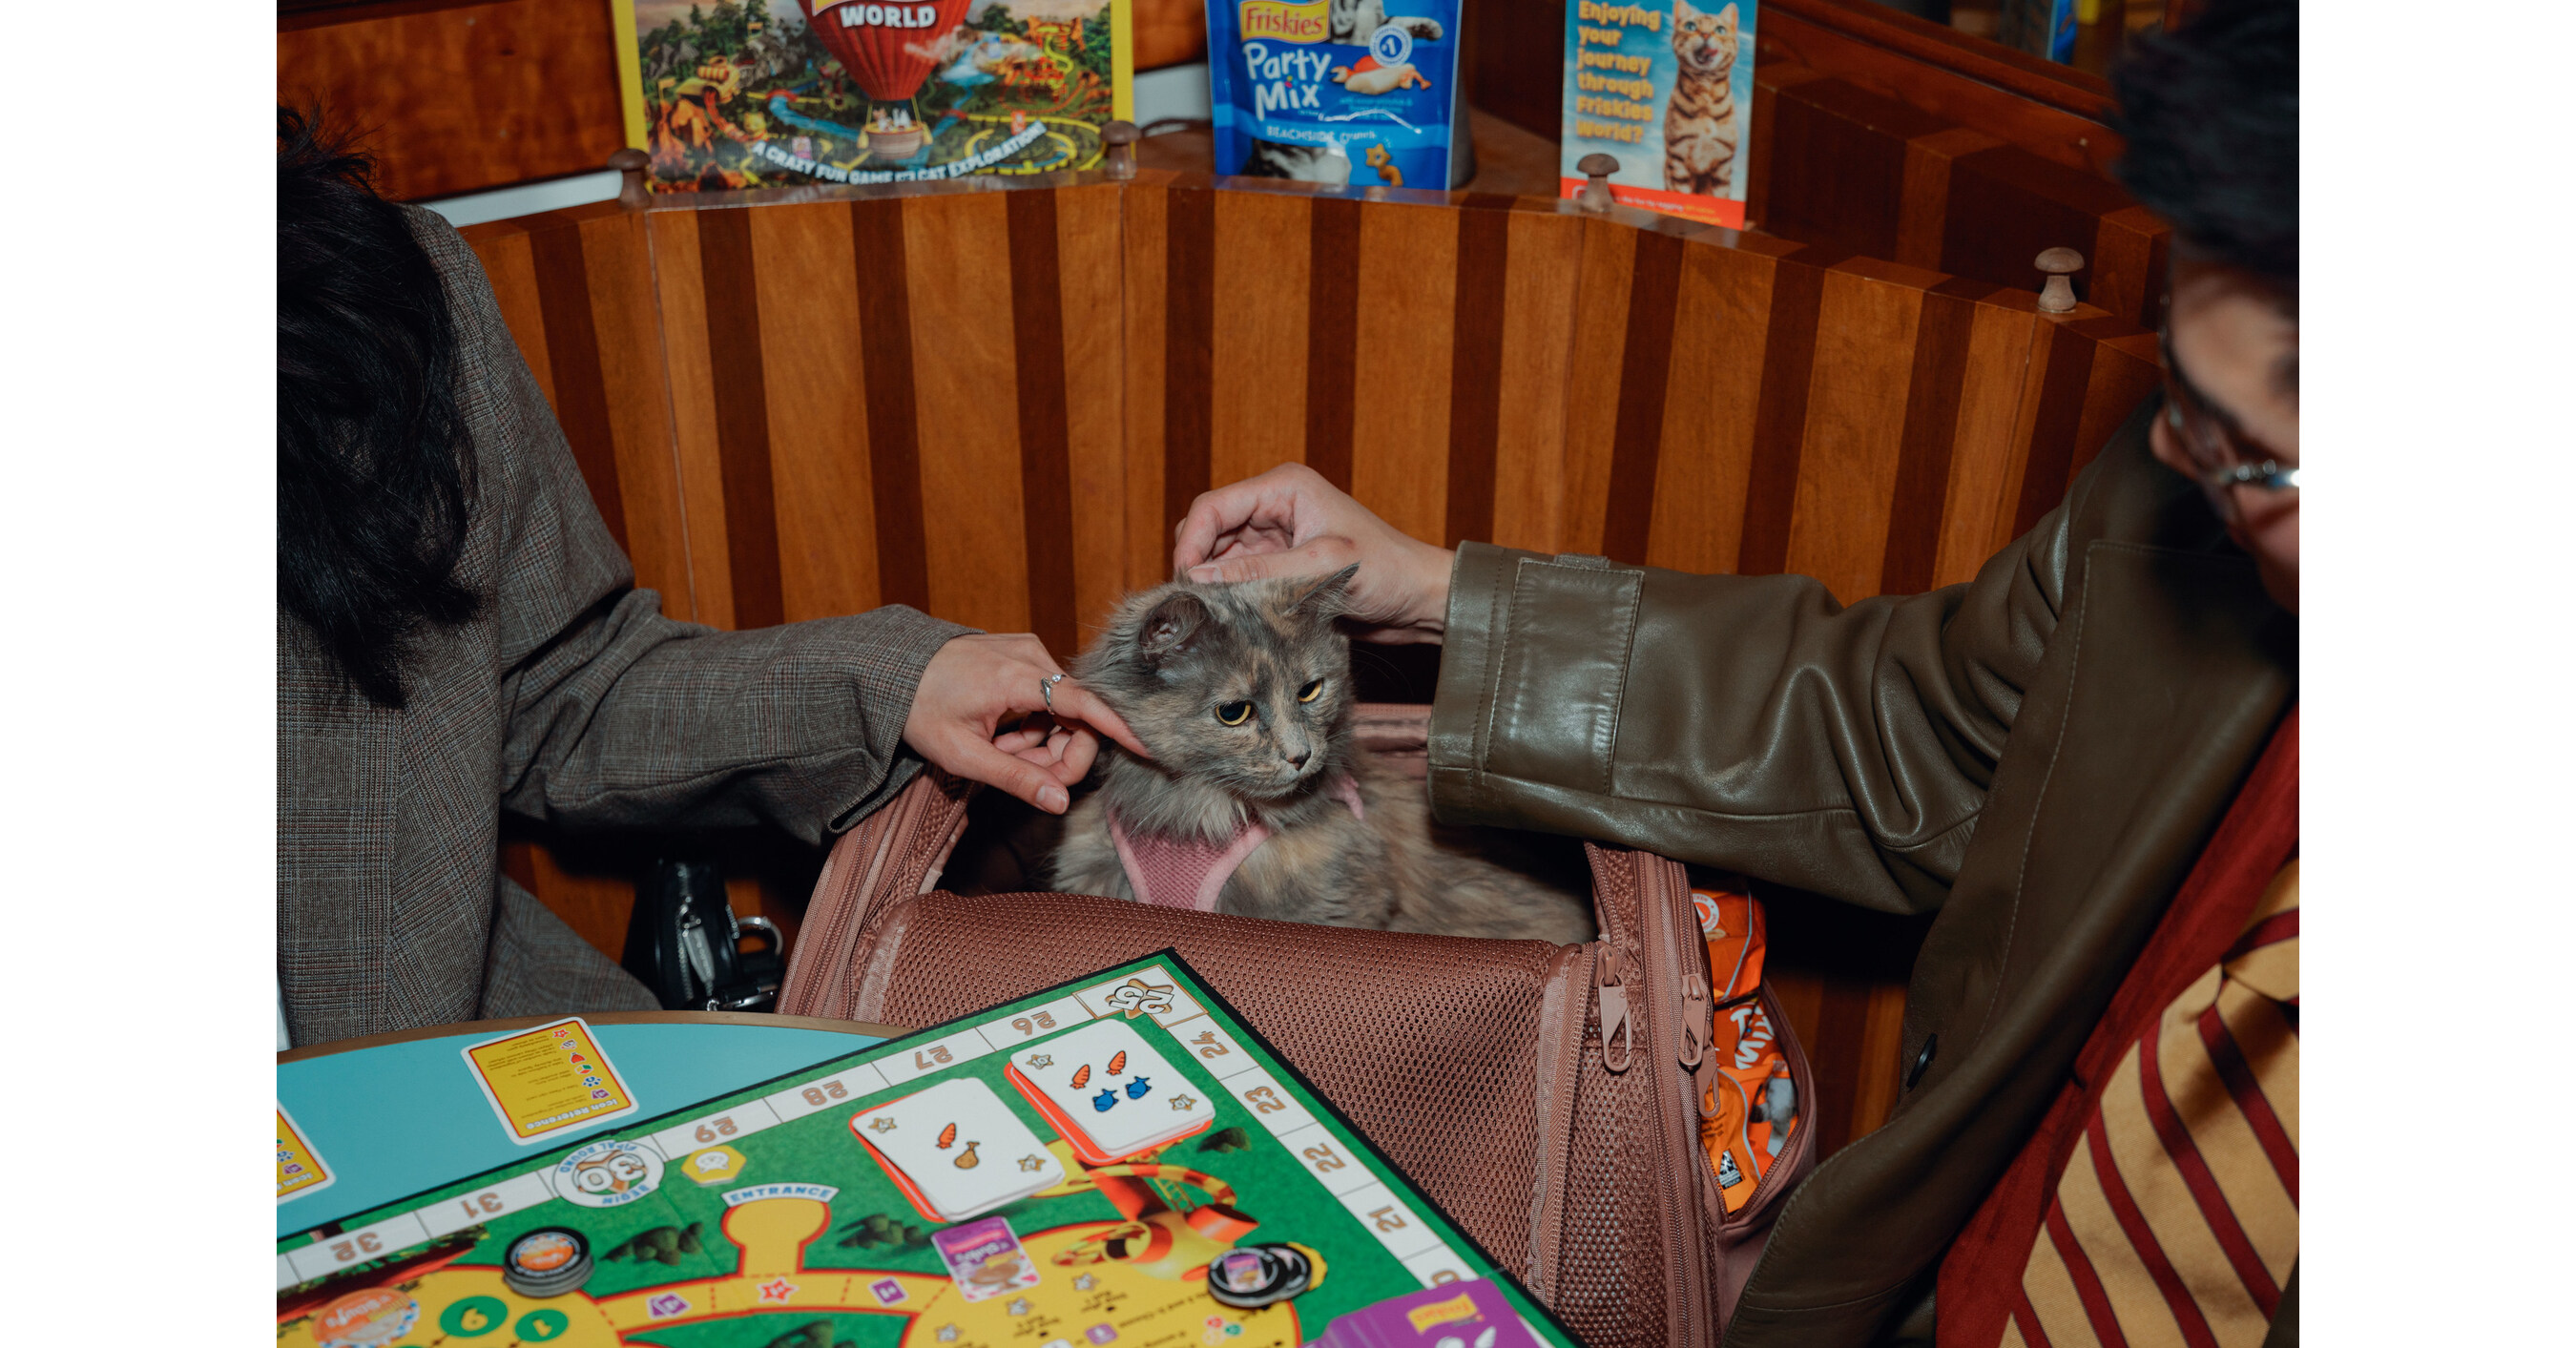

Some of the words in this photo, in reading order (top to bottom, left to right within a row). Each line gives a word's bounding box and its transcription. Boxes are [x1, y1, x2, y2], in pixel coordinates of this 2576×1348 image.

[840, 5, 936, 29] WORLD
[1246, 8, 1322, 36] Friskies
[1579, 1, 1661, 31] Enjoying
[1578, 26, 1622, 46] your
[1243, 43, 1332, 82] Party
[1577, 48, 1652, 76] journey
[1256, 80, 1320, 121] Mix
[1577, 73, 1653, 101] through
[1576, 96, 1652, 122] Friskies
[1266, 126, 1336, 143] BEACHSIDE
[1576, 119, 1644, 144] World?
[753, 140, 766, 156] A
[766, 147, 816, 175] CRAZY
[816, 163, 848, 182] FUN
[848, 170, 893, 185] GAME
[917, 165, 947, 181] CAT
[1109, 984, 1175, 1015] 25
[1011, 1010, 1058, 1036] 26
[914, 1044, 955, 1072] 27
[1191, 1030, 1230, 1059] 24
[592, 1097, 619, 1111] Icon
[800, 1079, 850, 1107] 28
[1244, 1085, 1288, 1115] 23
[525, 1105, 591, 1130] Reference
[695, 1115, 739, 1143] 29
[559, 1142, 597, 1174] ROUND
[1302, 1142, 1346, 1173] 22
[576, 1151, 650, 1193] 30
[460, 1192, 506, 1220] 31
[601, 1183, 653, 1207] BEGIN
[729, 1186, 833, 1203] ENTRANCE
[1367, 1204, 1408, 1234] 21
[327, 1231, 383, 1262] 32
